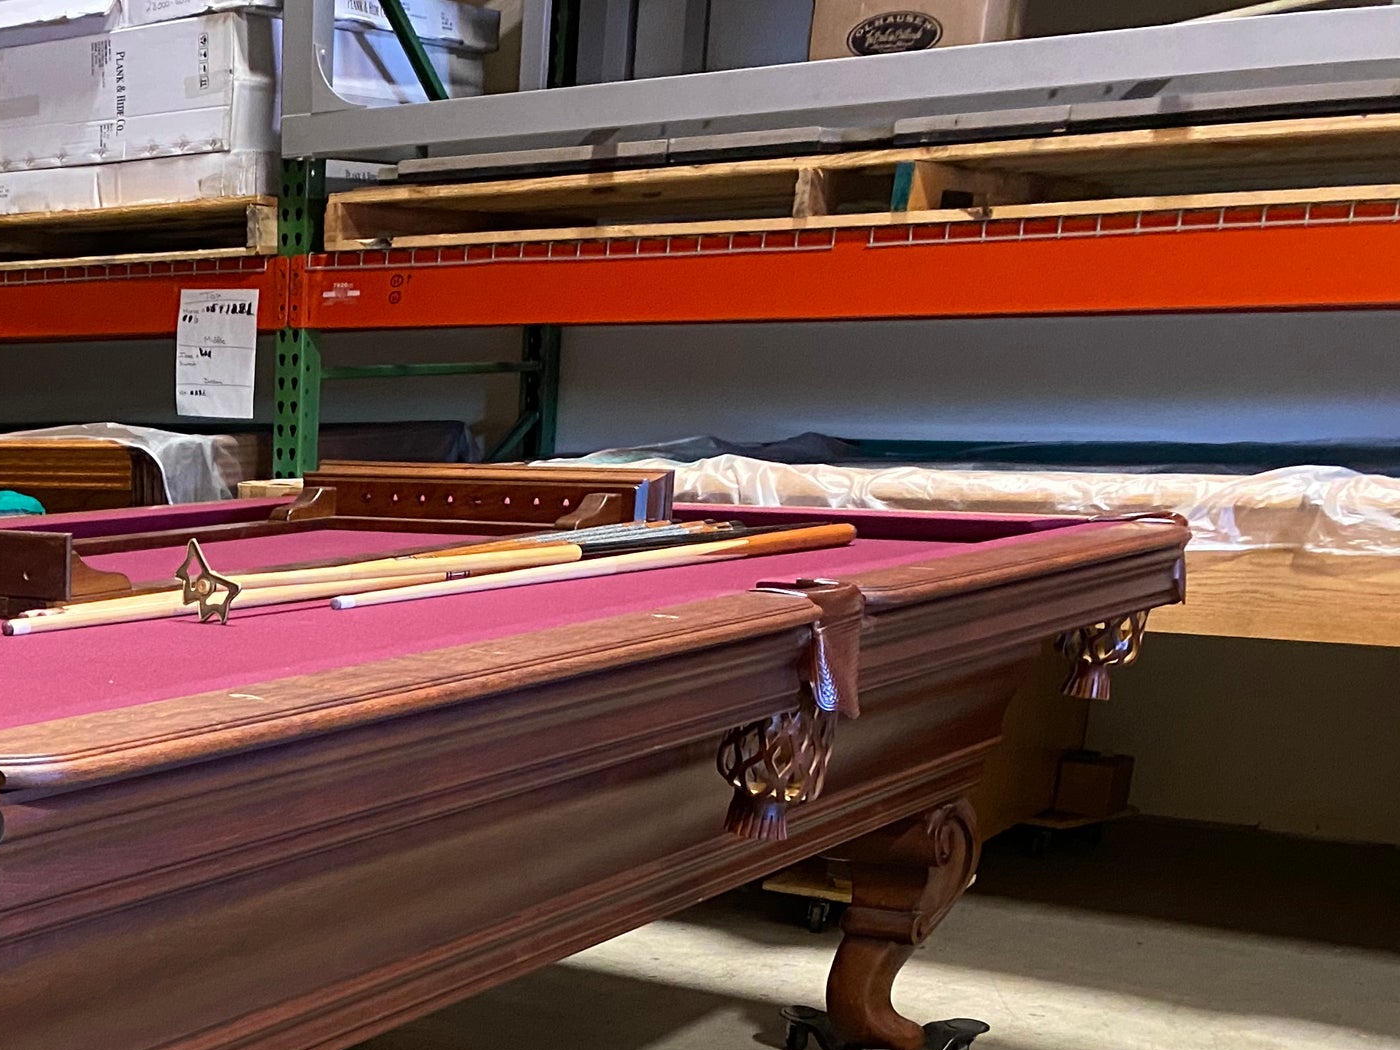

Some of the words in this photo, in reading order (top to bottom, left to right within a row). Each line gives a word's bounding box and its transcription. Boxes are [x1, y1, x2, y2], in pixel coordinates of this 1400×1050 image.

[855, 14, 936, 37] OLHAUSEN
[115, 51, 126, 83] PLANK
[116, 85, 126, 93] &
[116, 95, 126, 117] HIDE
